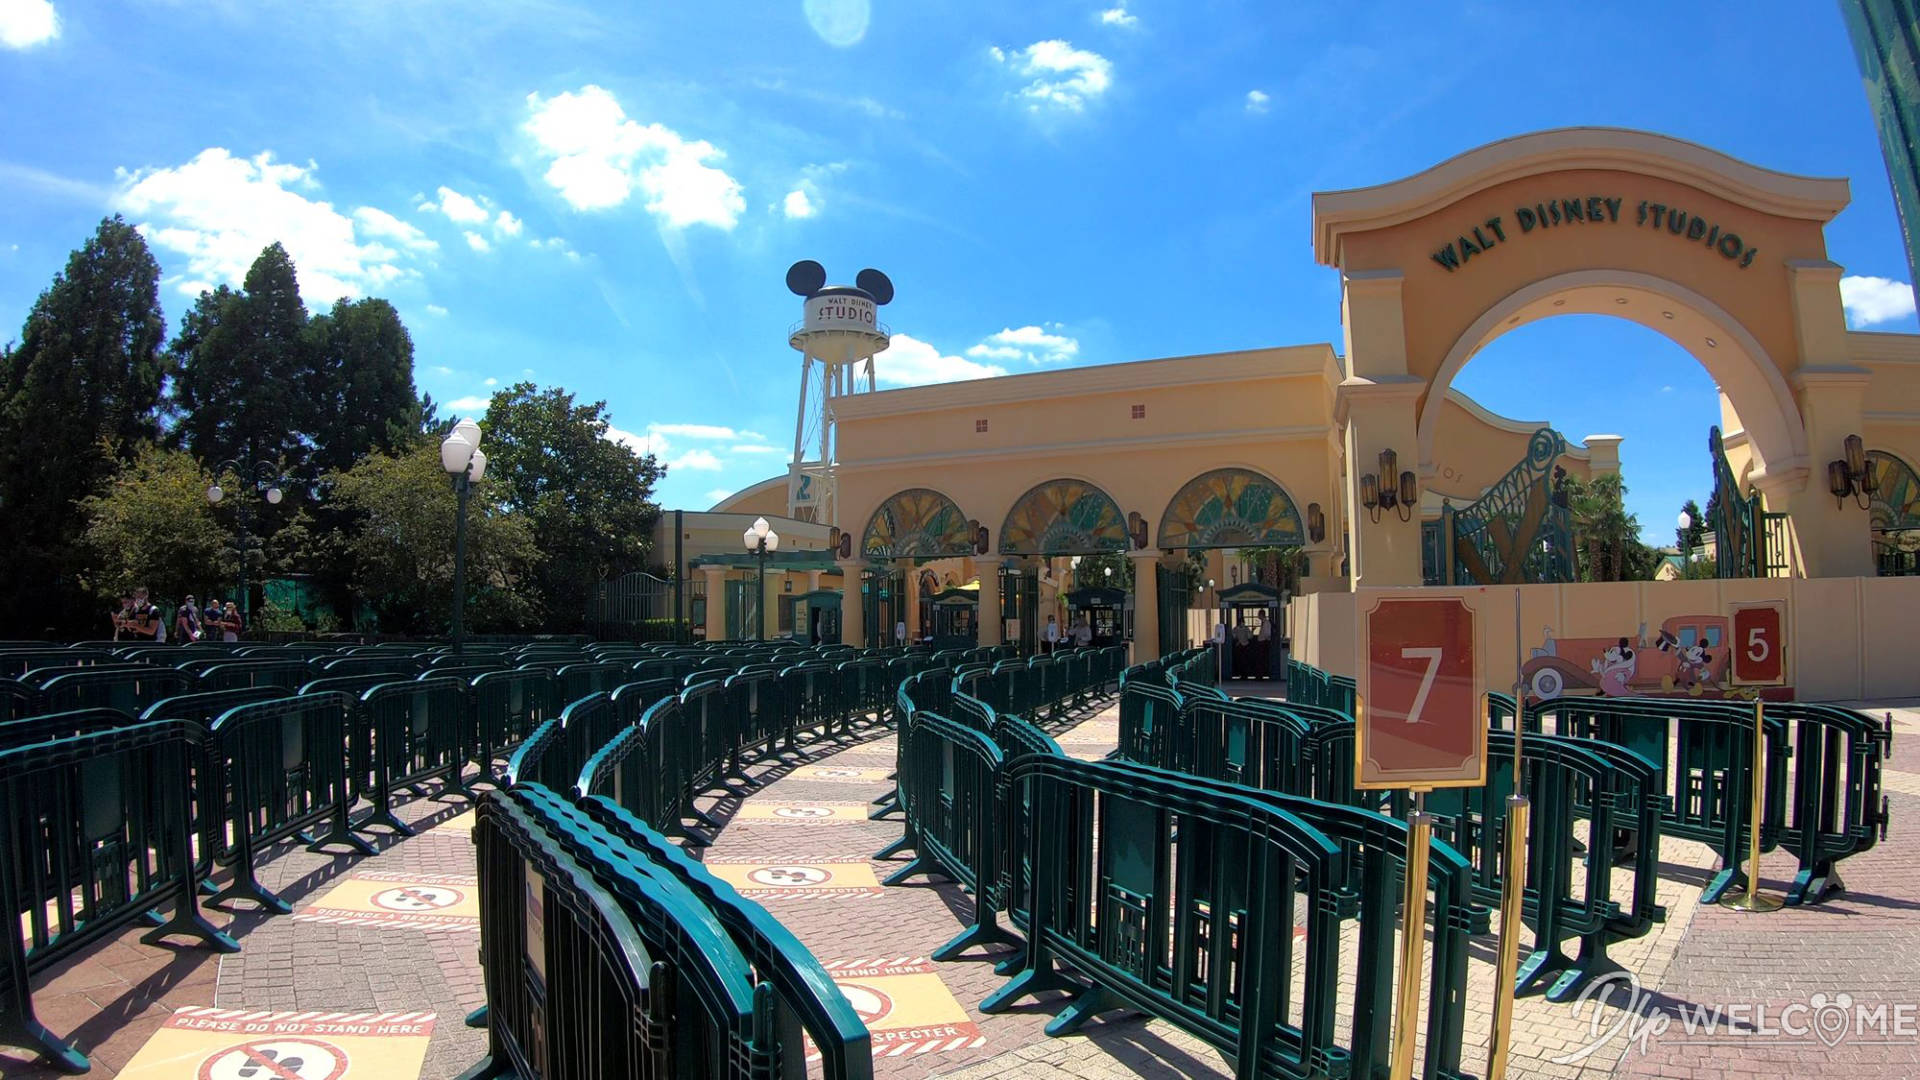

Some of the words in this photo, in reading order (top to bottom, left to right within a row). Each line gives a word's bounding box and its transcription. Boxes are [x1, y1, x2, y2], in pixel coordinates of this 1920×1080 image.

[1430, 215, 1506, 273] WALT
[1515, 197, 1622, 233] DISNEY
[1637, 200, 1757, 269] STUDIOS
[850, 298, 872, 309] DISNEY
[1746, 627, 1769, 662] 5
[1401, 647, 1443, 724] 7
[318, 908, 383, 919] DISTANCE
[831, 967, 879, 977] STAND
[884, 965, 923, 975] HERE
[175, 1017, 239, 1032] PLEASE
[245, 1022, 269, 1033] DO
[274, 1022, 310, 1033] NOT
[314, 1023, 370, 1034] STAND
[377, 1024, 423, 1034] HERE
[872, 1026, 958, 1043] SPECTER
